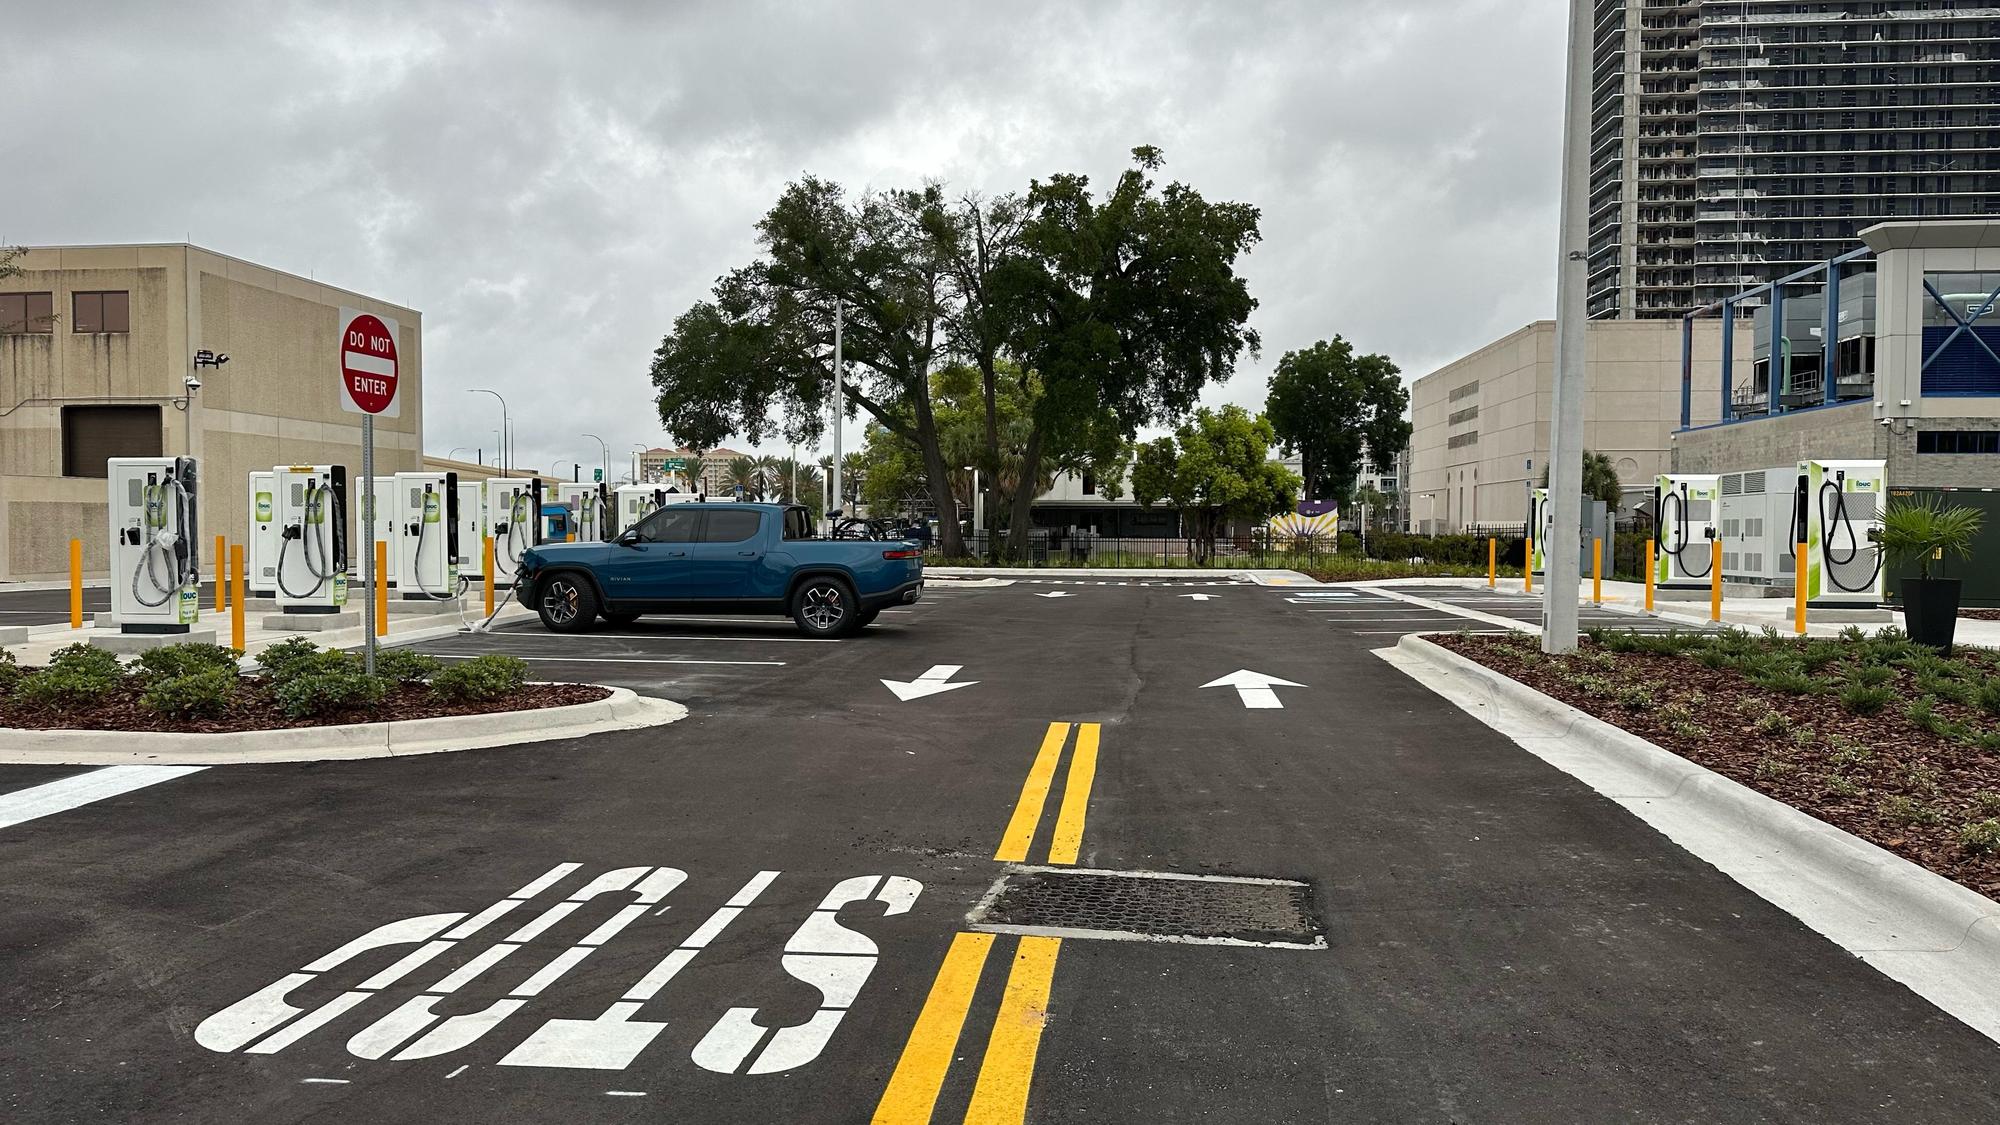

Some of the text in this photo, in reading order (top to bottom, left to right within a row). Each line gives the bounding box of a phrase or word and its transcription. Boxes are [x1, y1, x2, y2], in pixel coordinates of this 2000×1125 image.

[350, 331, 391, 353] DO NOT
[354, 377, 387, 396] ENTER
[182, 592, 197, 600] OUC
[194, 862, 924, 1075] STOP
